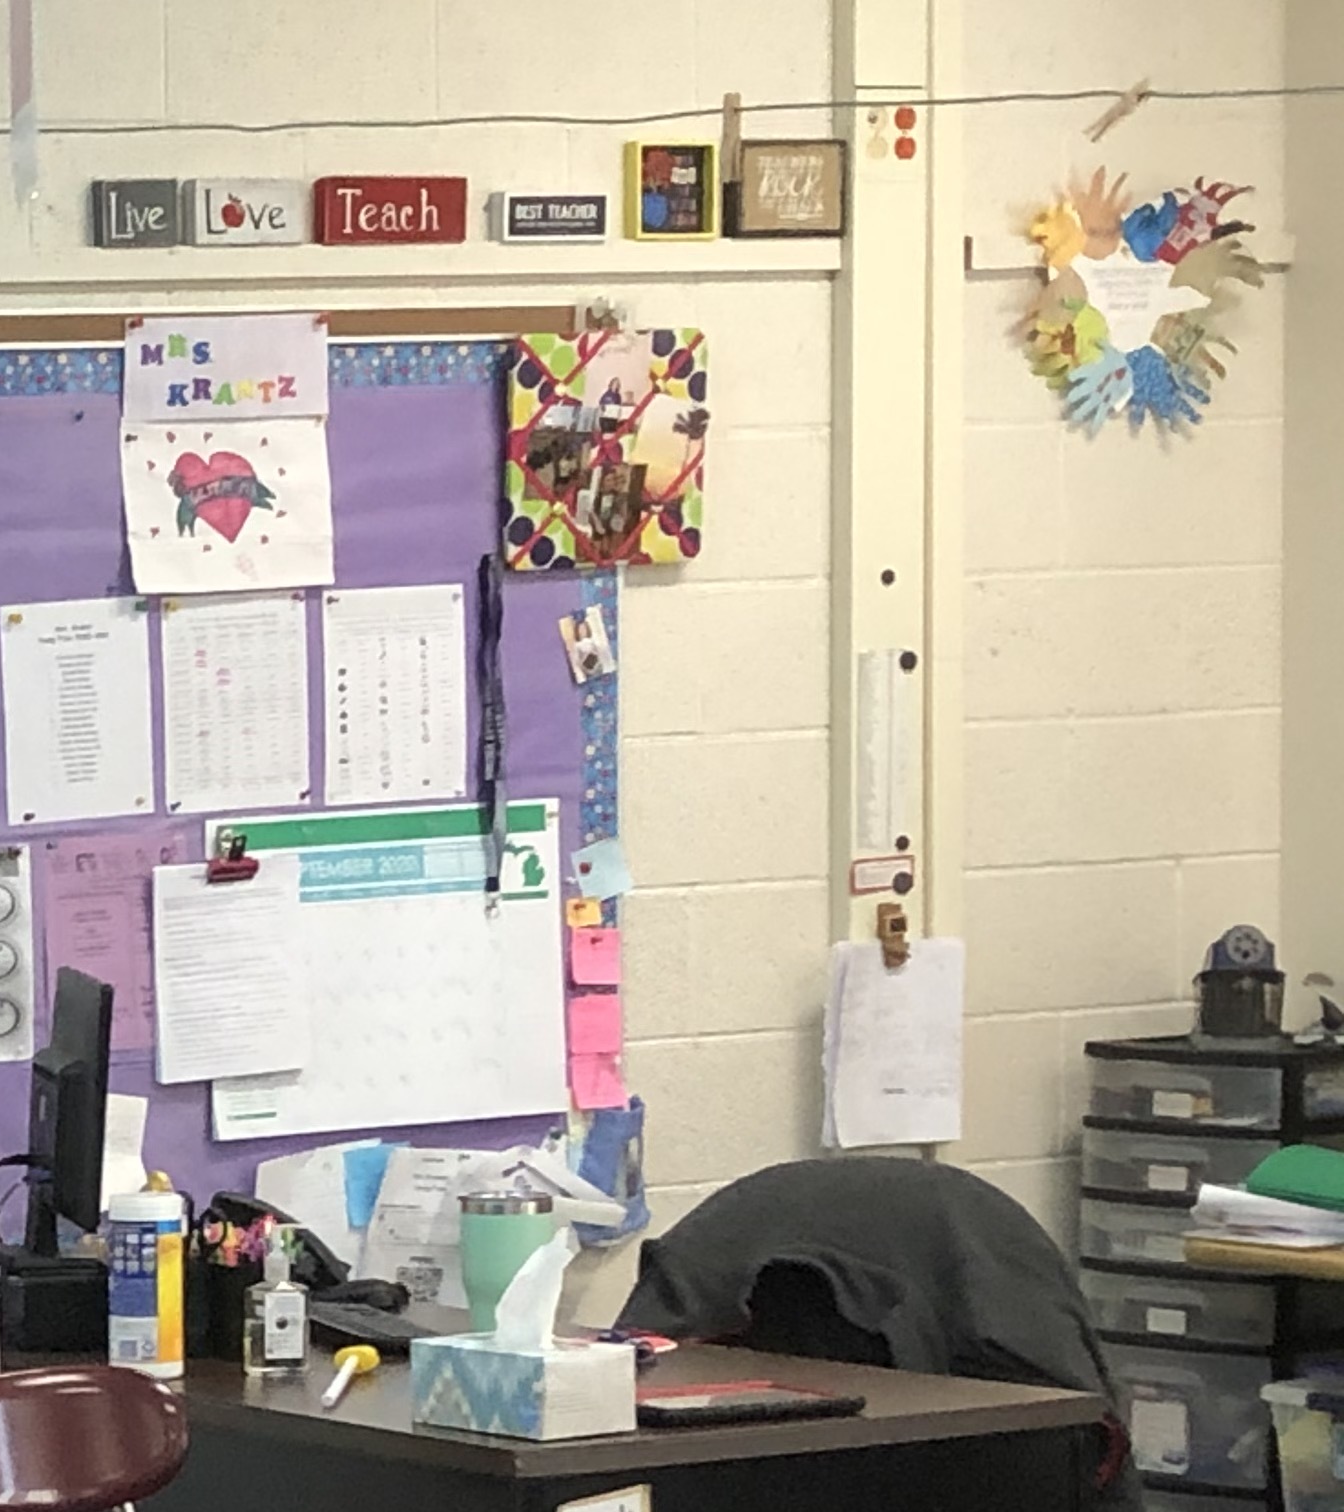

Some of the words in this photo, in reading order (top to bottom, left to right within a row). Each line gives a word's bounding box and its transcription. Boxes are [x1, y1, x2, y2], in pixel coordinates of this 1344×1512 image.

[109, 190, 168, 239] Live
[337, 188, 440, 233] Teach
[515, 203, 544, 219] BEST
[548, 203, 598, 219] TEACHER
[166, 375, 297, 407] KRANTZ
